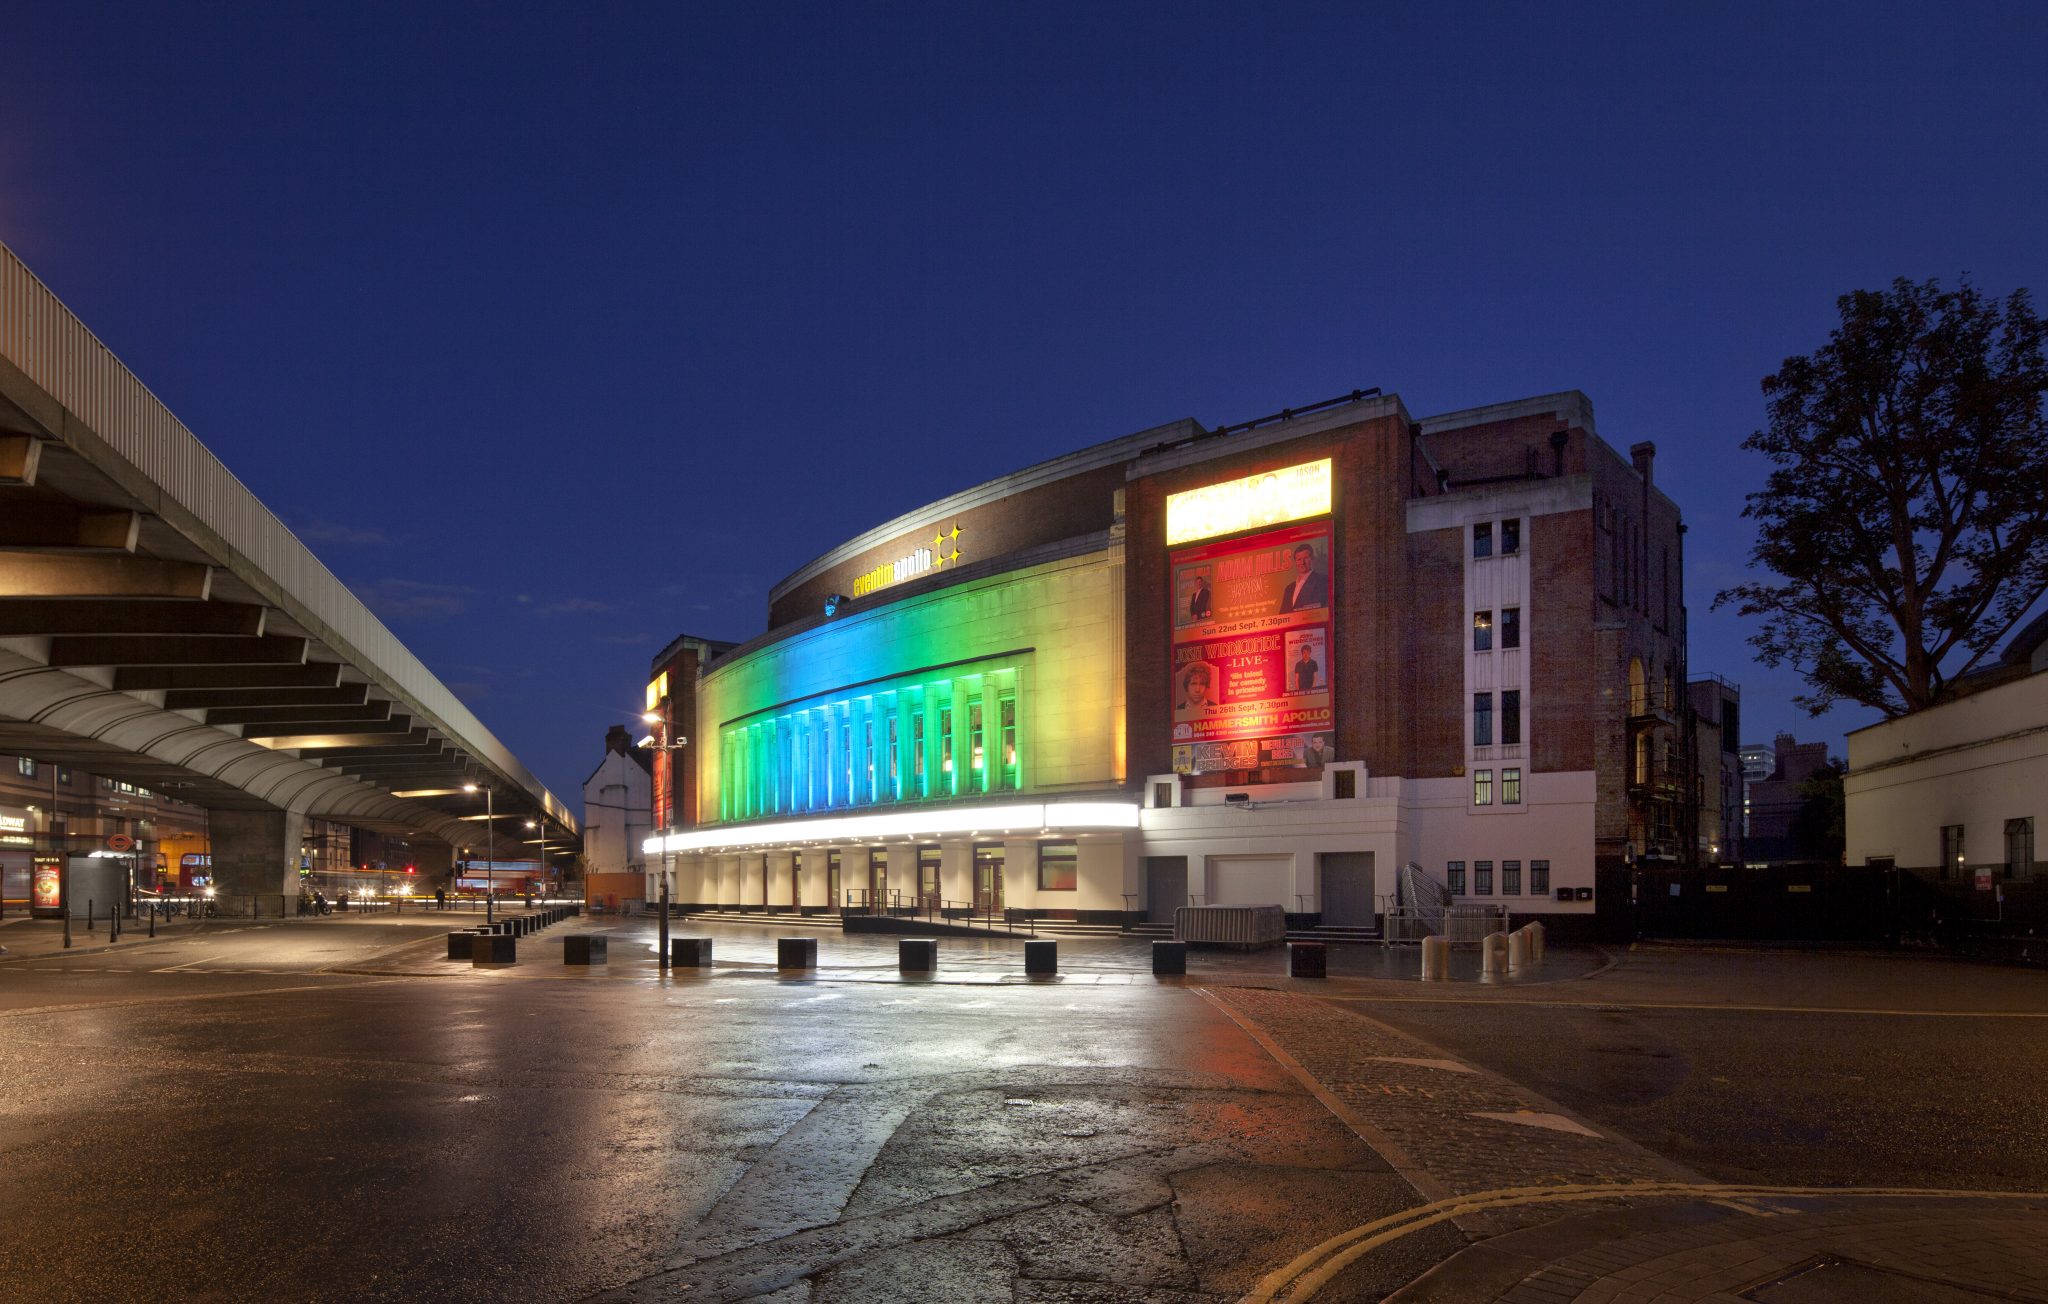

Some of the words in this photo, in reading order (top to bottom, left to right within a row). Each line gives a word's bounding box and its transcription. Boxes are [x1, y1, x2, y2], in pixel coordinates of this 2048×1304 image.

[1216, 555, 1253, 581] ADAM
[1256, 548, 1292, 575] HILLS
[1202, 628, 1217, 636] Sun
[1218, 624, 1237, 633] 22nd
[1239, 620, 1259, 630] Sept,
[1260, 616, 1291, 627] 7.30pm
[1175, 645, 1203, 663] JOSH
[1204, 634, 1281, 659] WIDDICOMBE
[1240, 677, 1266, 687] comedy
[1243, 669, 1264, 679] talent
[1204, 708, 1218, 716] Thu
[1219, 705, 1236, 714] 26th
[1259, 701, 1289, 711] 7.30pm
[1193, 713, 1279, 732] HAMMERSMITH
[1282, 709, 1331, 723] APOLLO
[1196, 740, 1259, 761] KEVIN
[1196, 756, 1259, 771] BRIDGES
